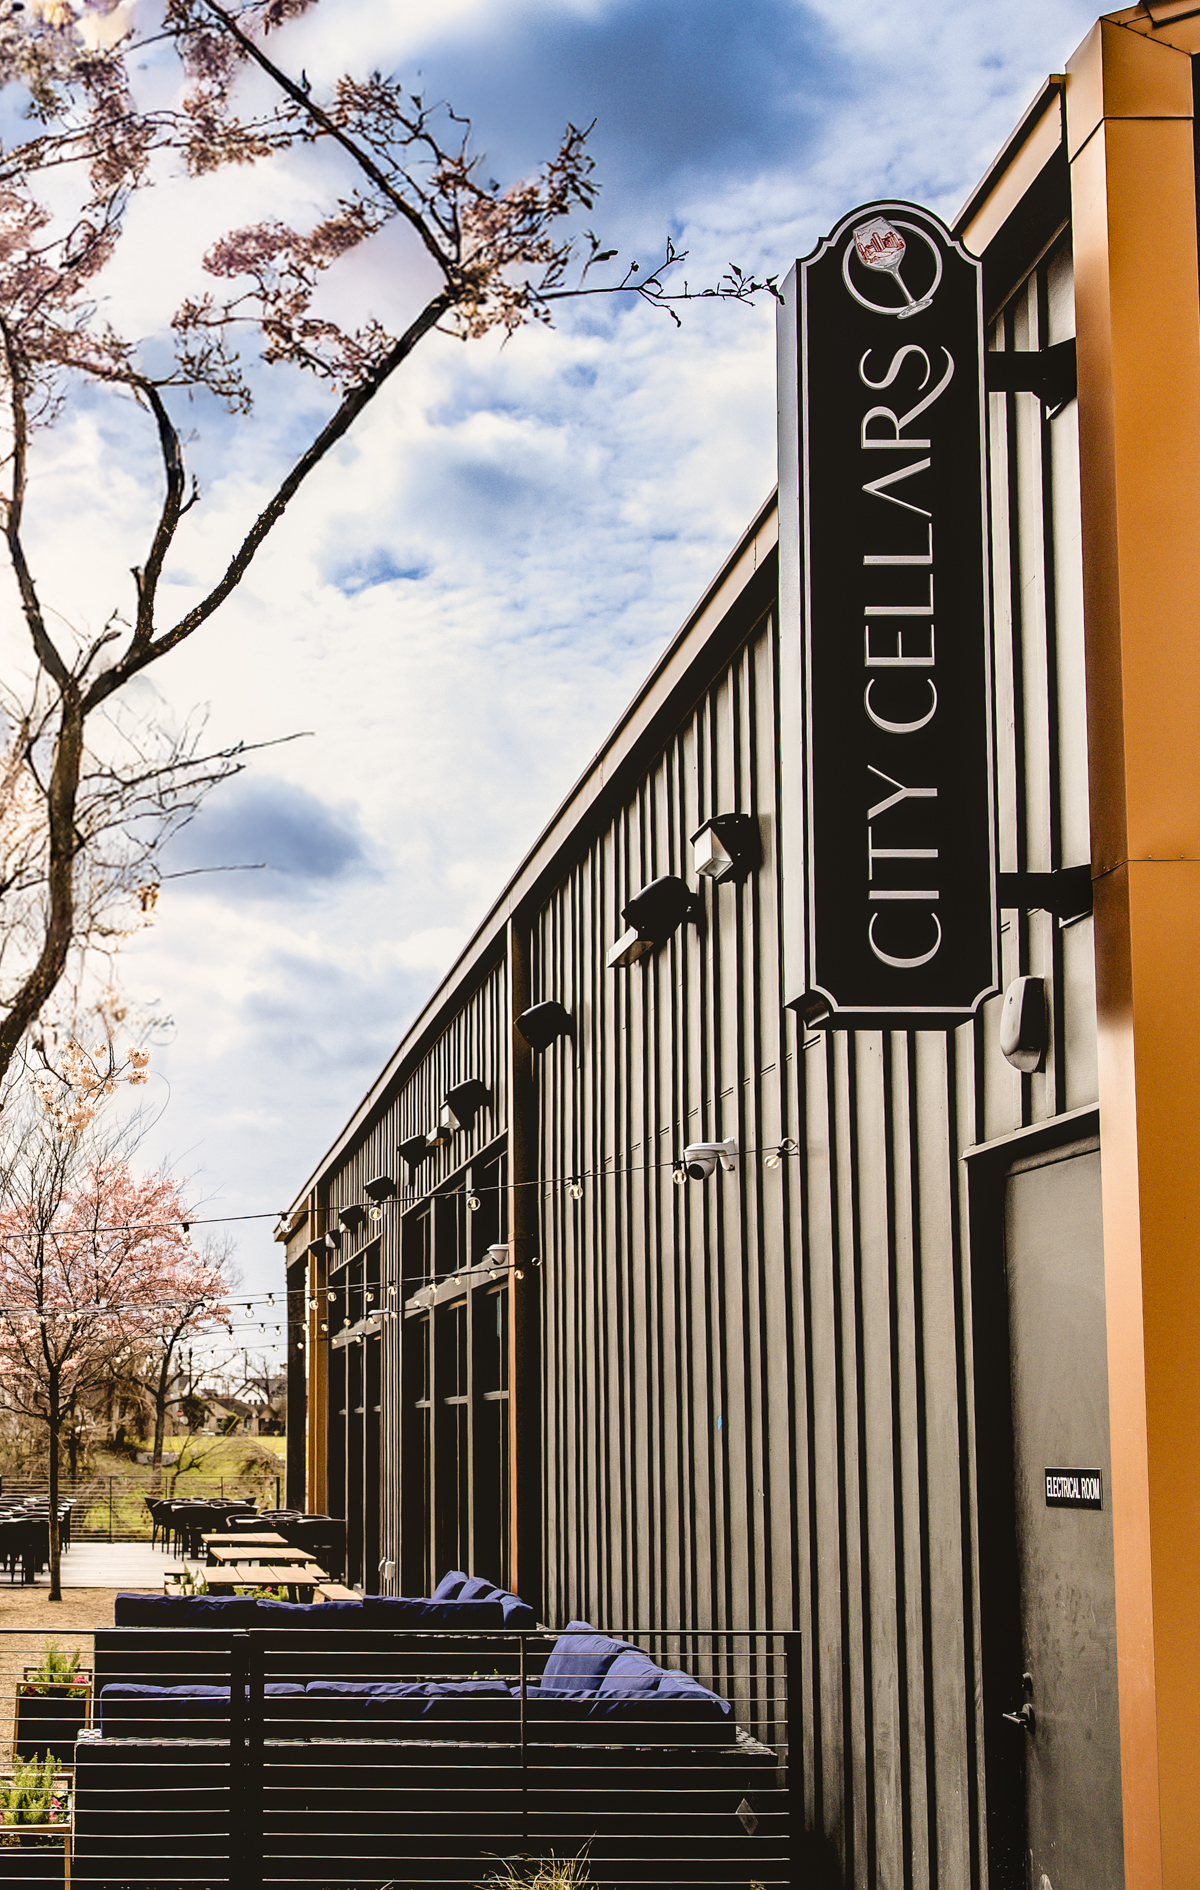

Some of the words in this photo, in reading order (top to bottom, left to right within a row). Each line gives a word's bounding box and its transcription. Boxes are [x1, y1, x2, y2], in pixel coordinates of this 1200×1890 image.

[859, 344, 955, 734] CELLARS
[867, 764, 942, 968] CITY
[1046, 1476, 1081, 1499] ELECTRICAL
[1081, 1477, 1100, 1500] ROOM
